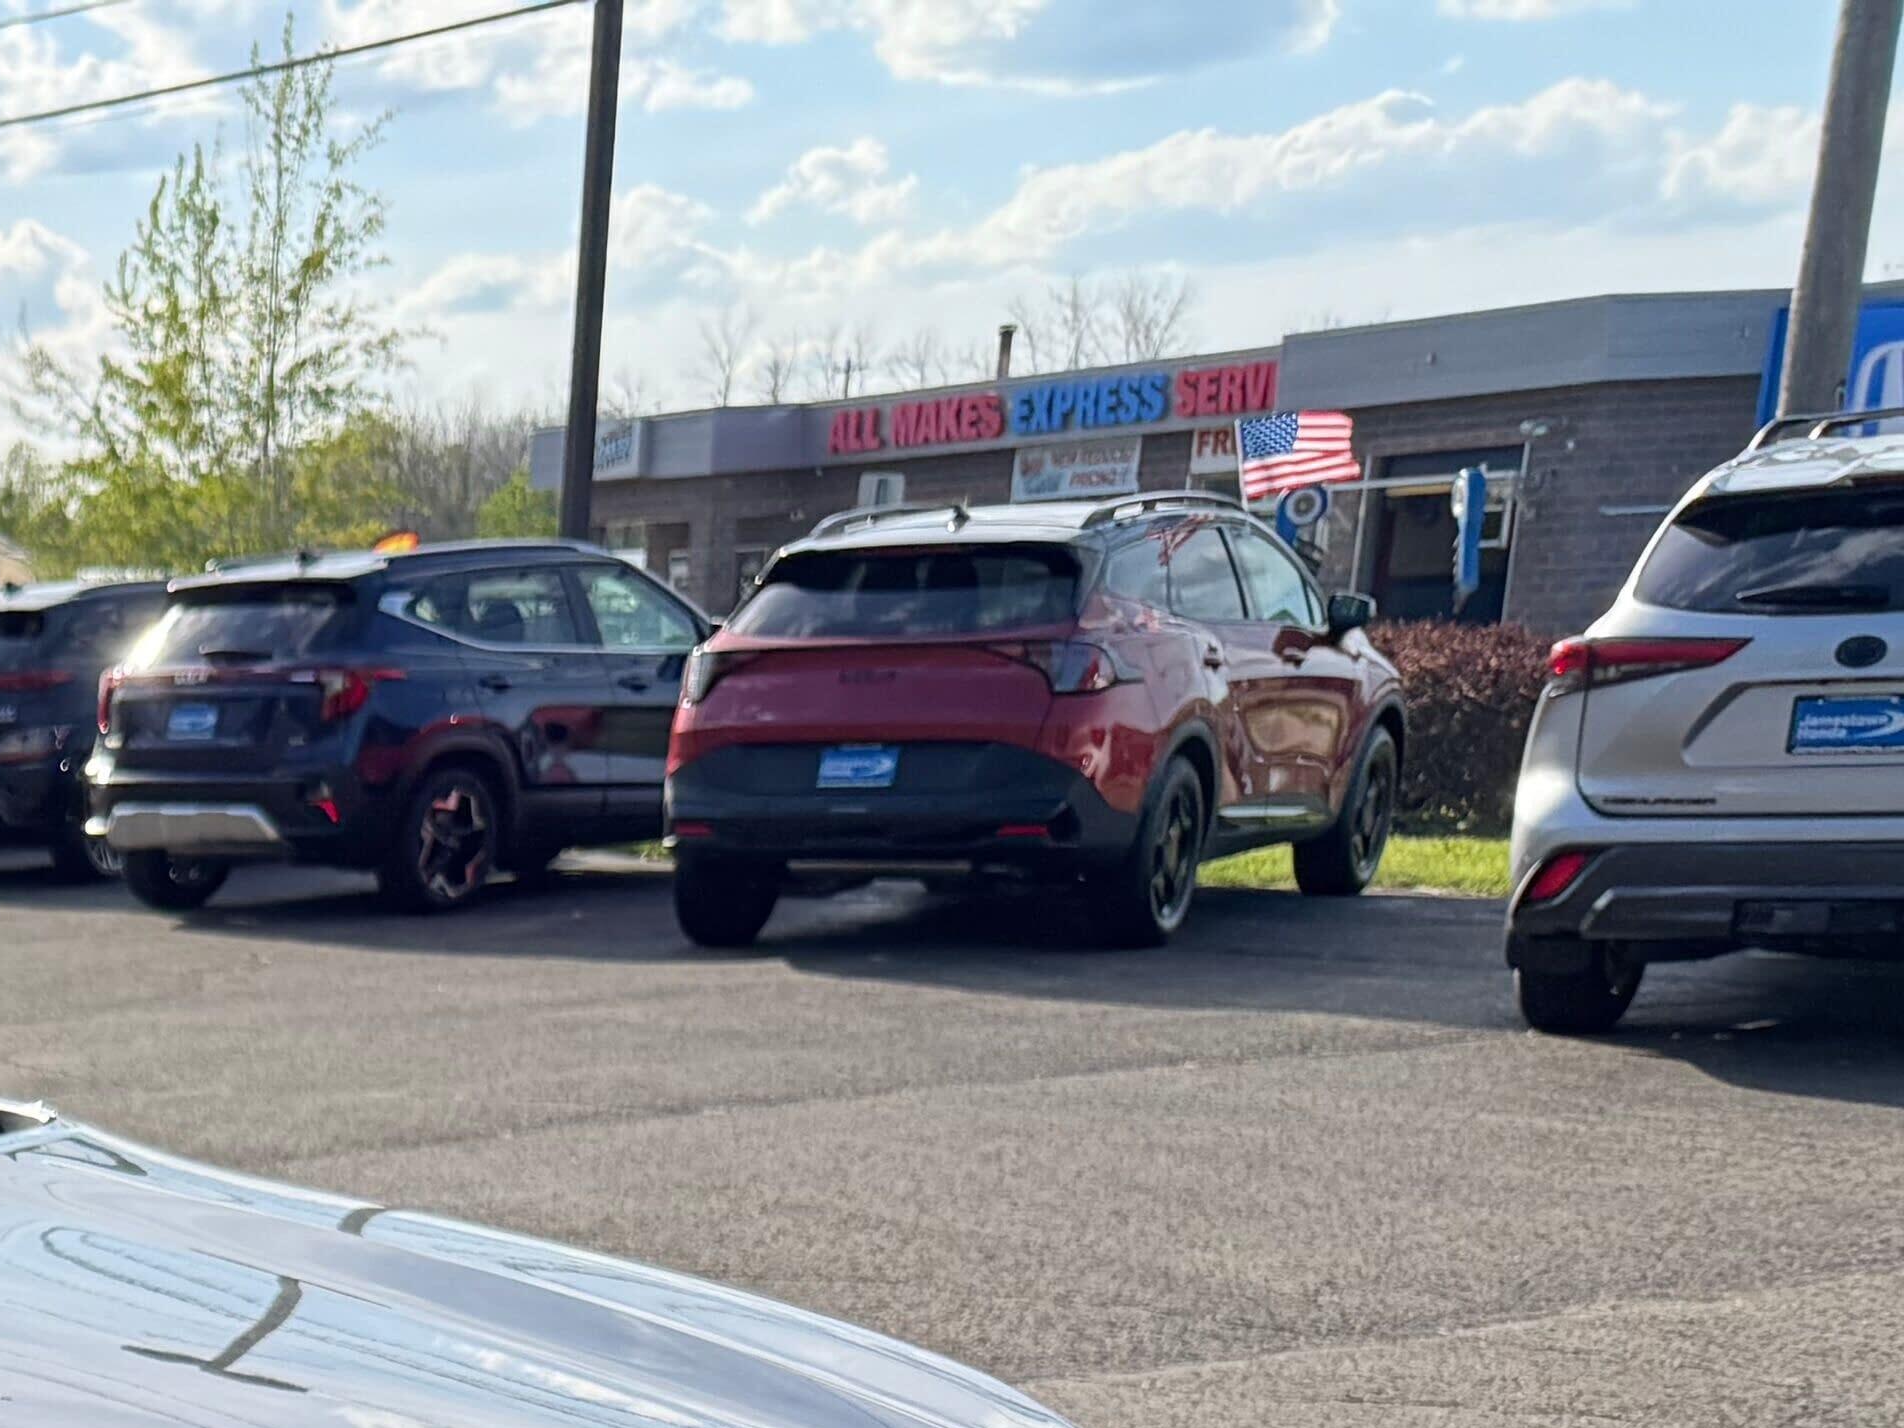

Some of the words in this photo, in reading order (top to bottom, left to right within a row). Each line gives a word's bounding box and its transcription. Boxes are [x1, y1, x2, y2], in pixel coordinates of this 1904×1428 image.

[828, 410, 882, 453] ALL
[892, 394, 1004, 447] MAKES
[1014, 372, 1167, 435] EXPRESS
[1799, 713, 1889, 728] Jamestown
[1797, 727, 1848, 740] Honda
